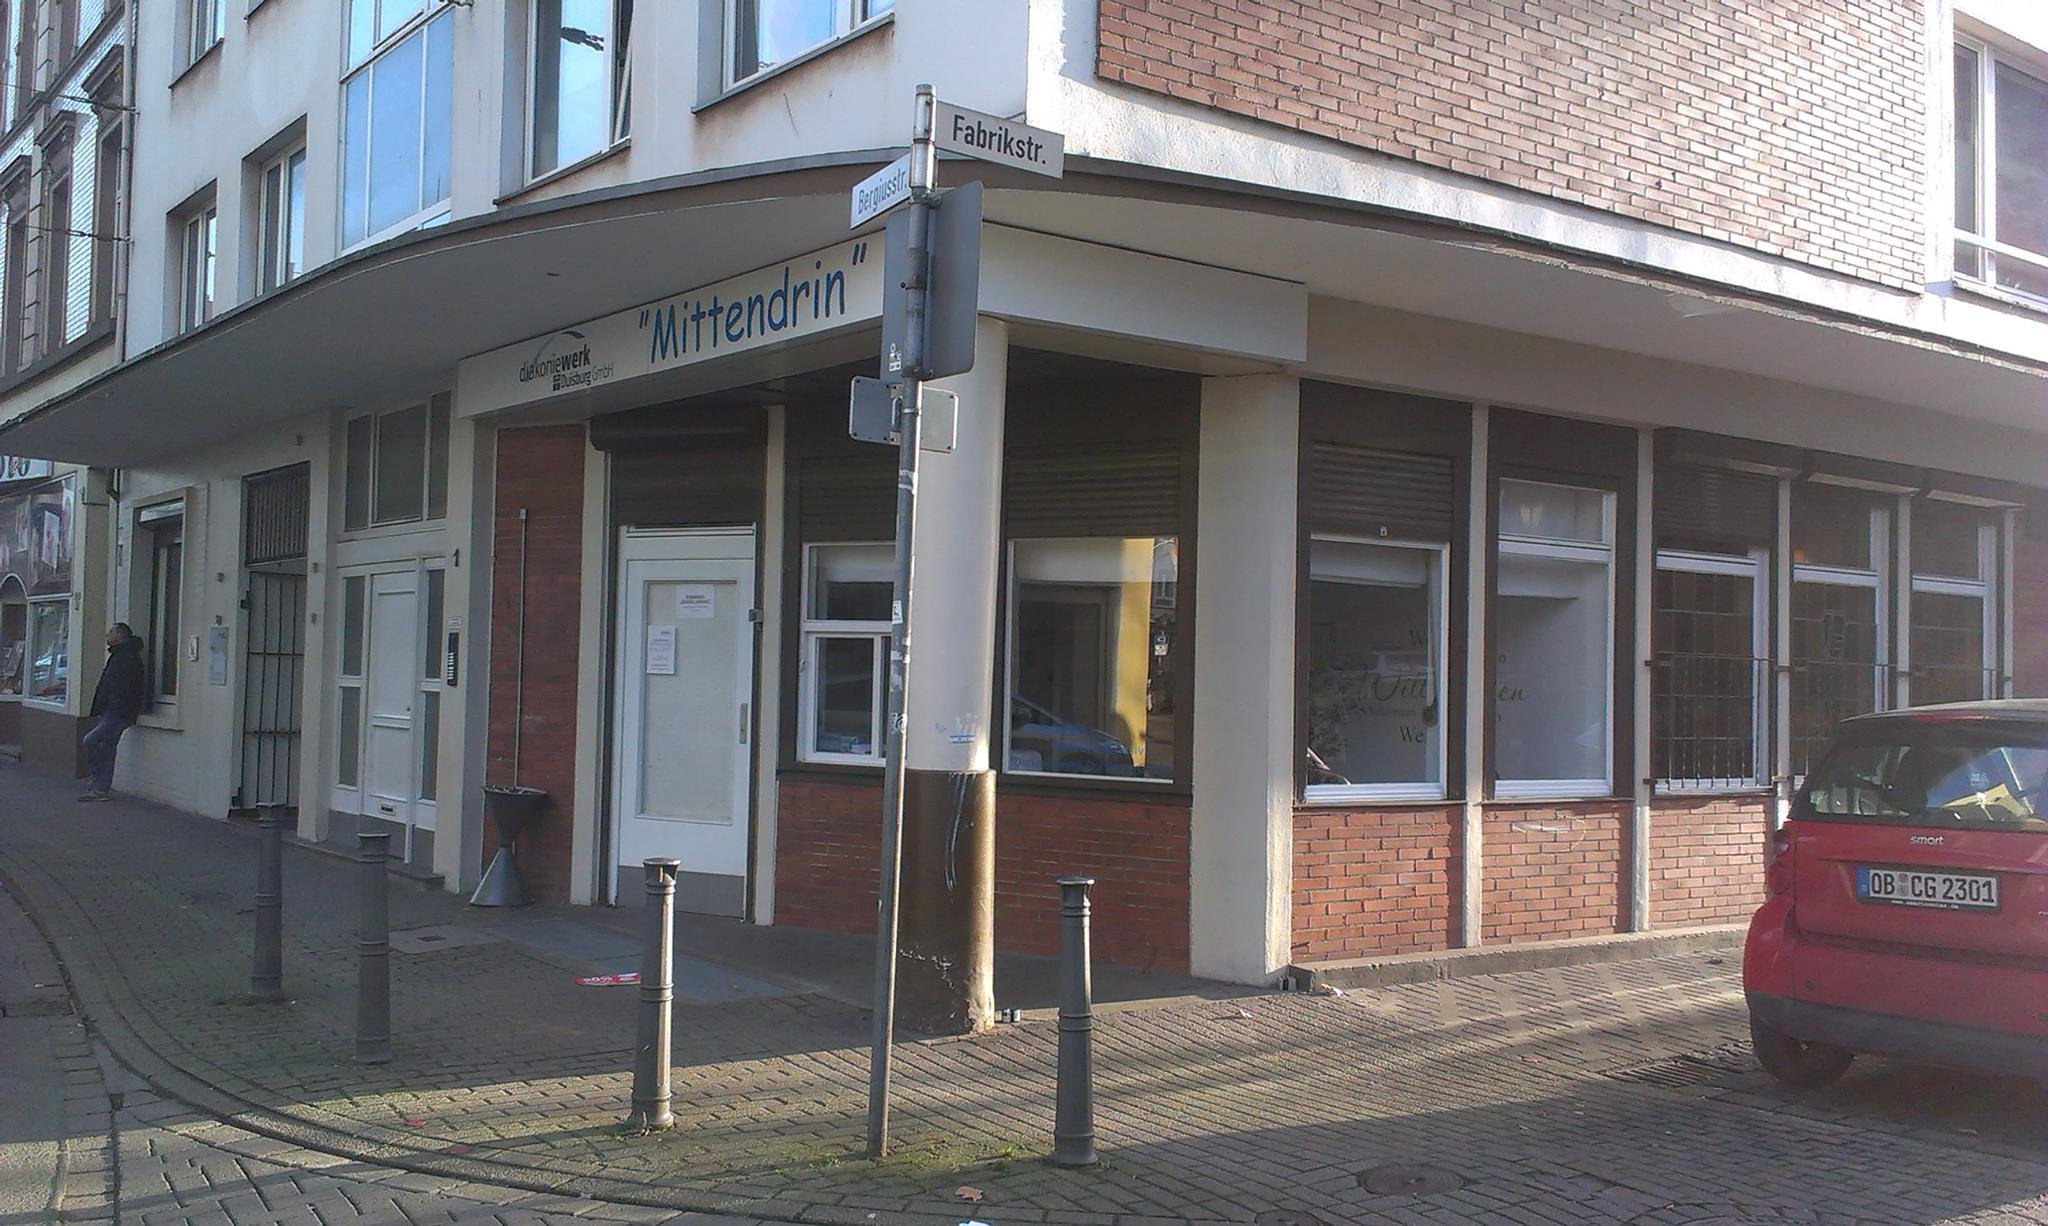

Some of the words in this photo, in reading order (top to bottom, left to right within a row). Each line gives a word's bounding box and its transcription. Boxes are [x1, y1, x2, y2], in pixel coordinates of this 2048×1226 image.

[952, 113, 1047, 165] Fabrikstr.
[857, 168, 908, 216] Bergiusstr.
[519, 343, 591, 383] diakoniewerk
[560, 370, 591, 389] Duisburg
[592, 363, 614, 381] GmbH
[452, 548, 460, 567] 1
[1910, 834, 1945, 846] smart
[1870, 872, 1896, 896] OB
[1911, 875, 1938, 899] CG
[1942, 877, 1995, 903] 2301
